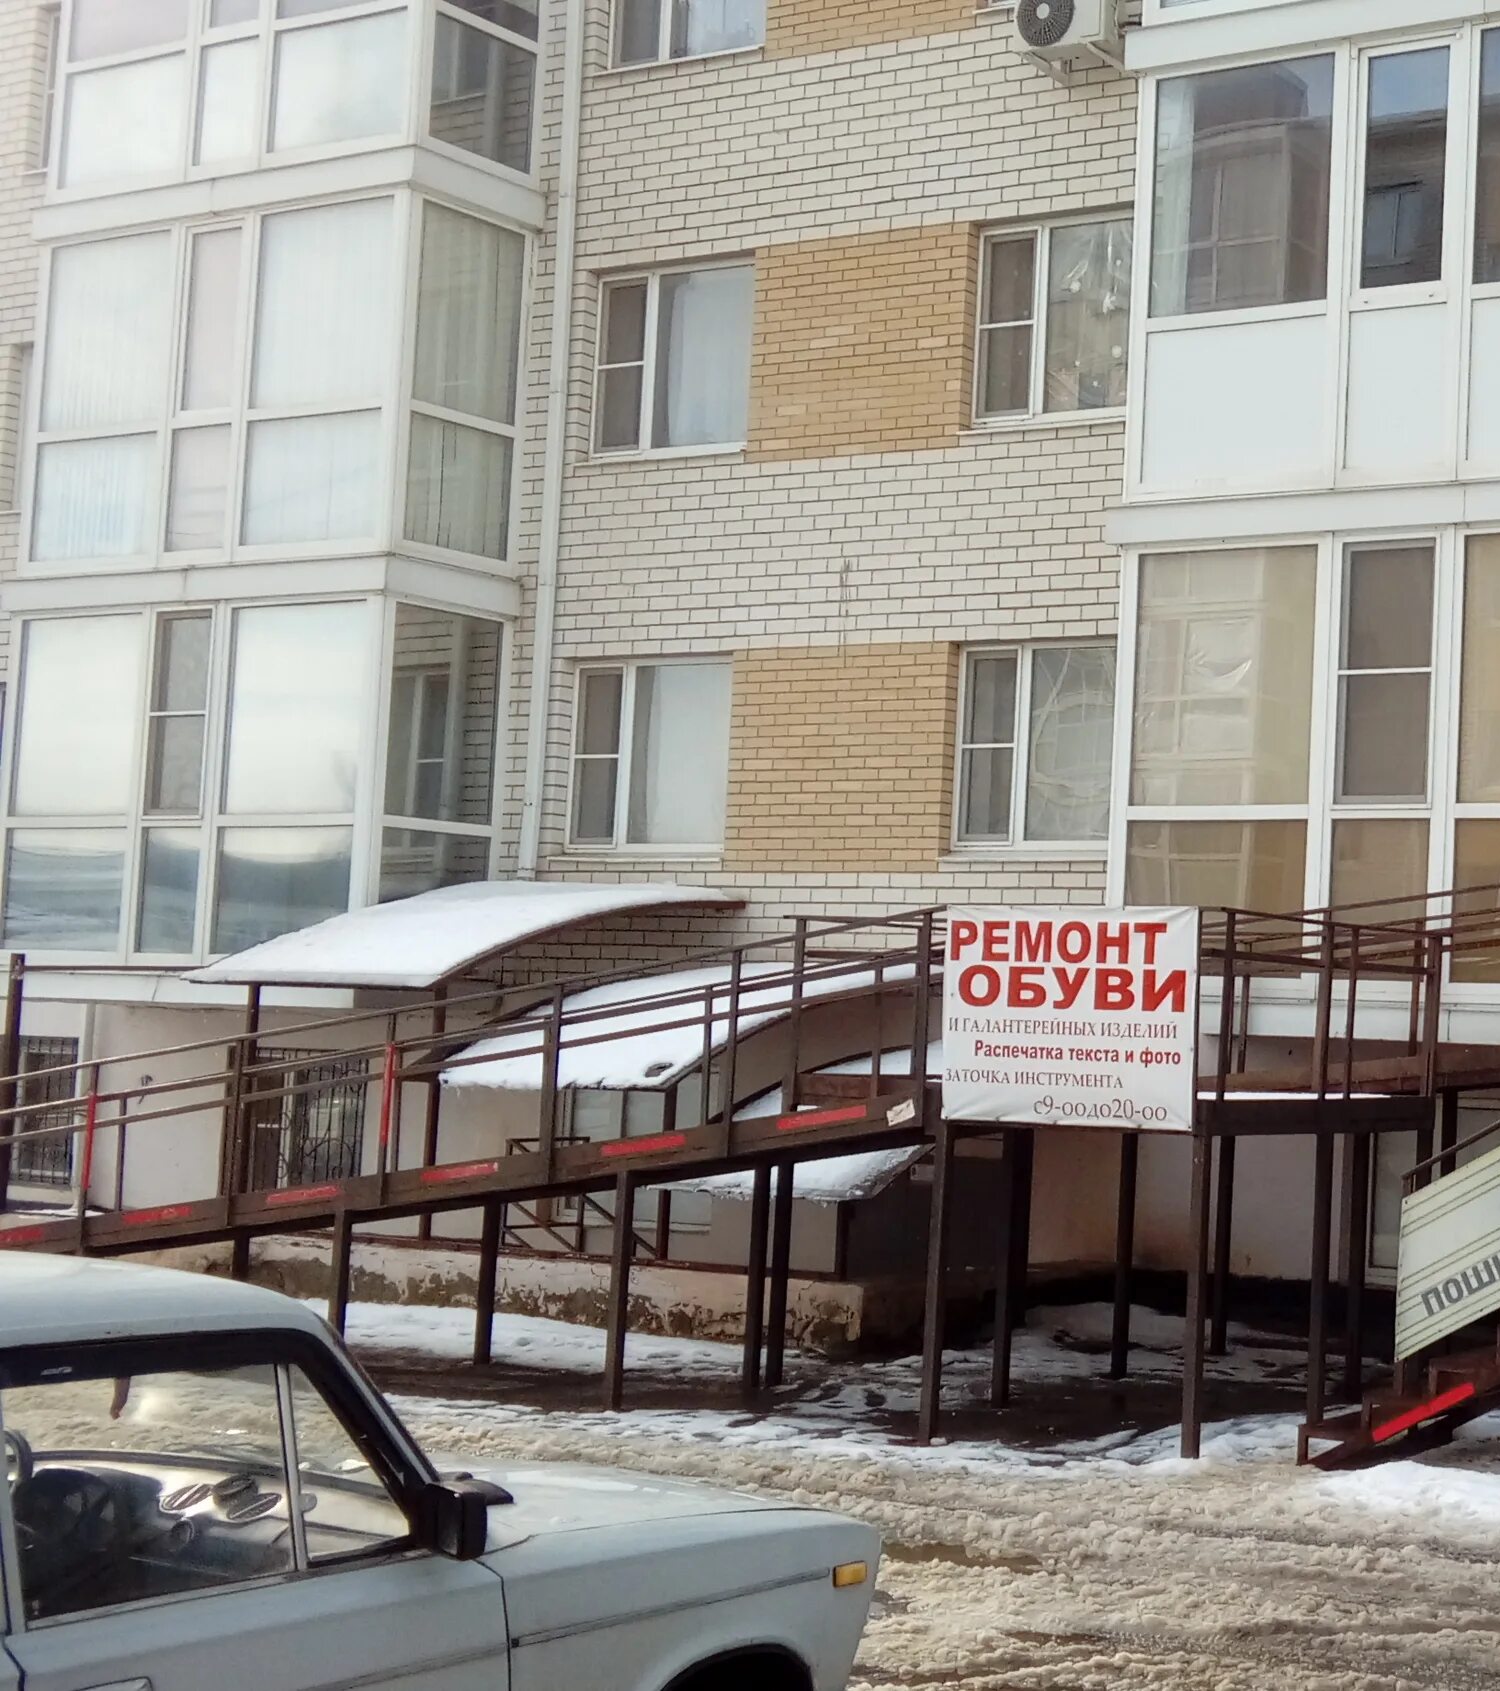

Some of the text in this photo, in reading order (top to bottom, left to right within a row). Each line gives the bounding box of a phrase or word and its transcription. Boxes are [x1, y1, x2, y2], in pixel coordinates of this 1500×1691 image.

[950, 920, 1168, 965] РЕМОНТ
[958, 965, 1187, 1013] ОБУВИ
[963, 1017, 1096, 1037] ГАЛАНТЕРЕЙНЫХ
[1100, 1020, 1178, 1040] ИЗДЕЛИЙ
[974, 1039, 1181, 1068] Распечатка текста и фото
[944, 1068, 1124, 1089] ЗАТОЧКА ИНСТРУМЕНТА
